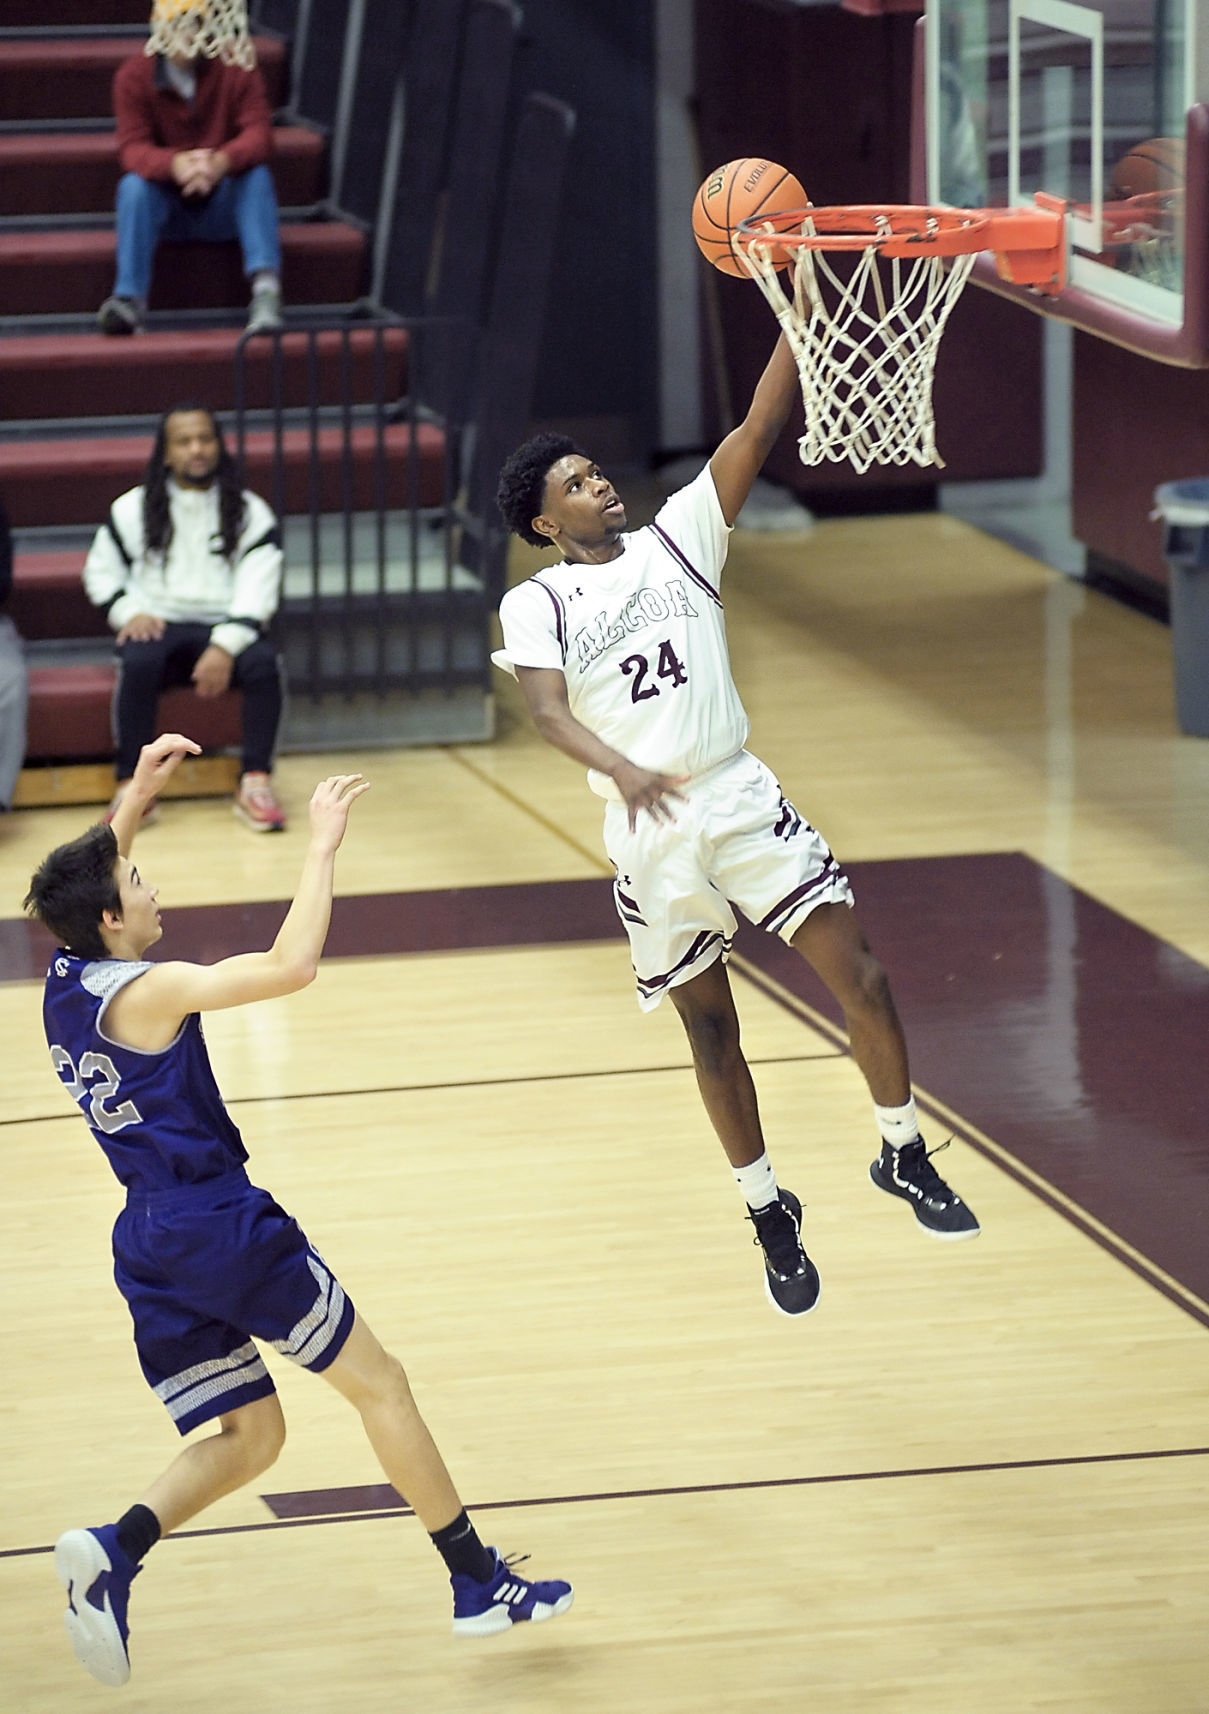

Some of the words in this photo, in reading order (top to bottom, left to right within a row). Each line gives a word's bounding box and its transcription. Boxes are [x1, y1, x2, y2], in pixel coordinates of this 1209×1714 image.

[574, 579, 699, 674] ALCOA
[618, 639, 688, 704] 24
[50, 1044, 144, 1135] 22
